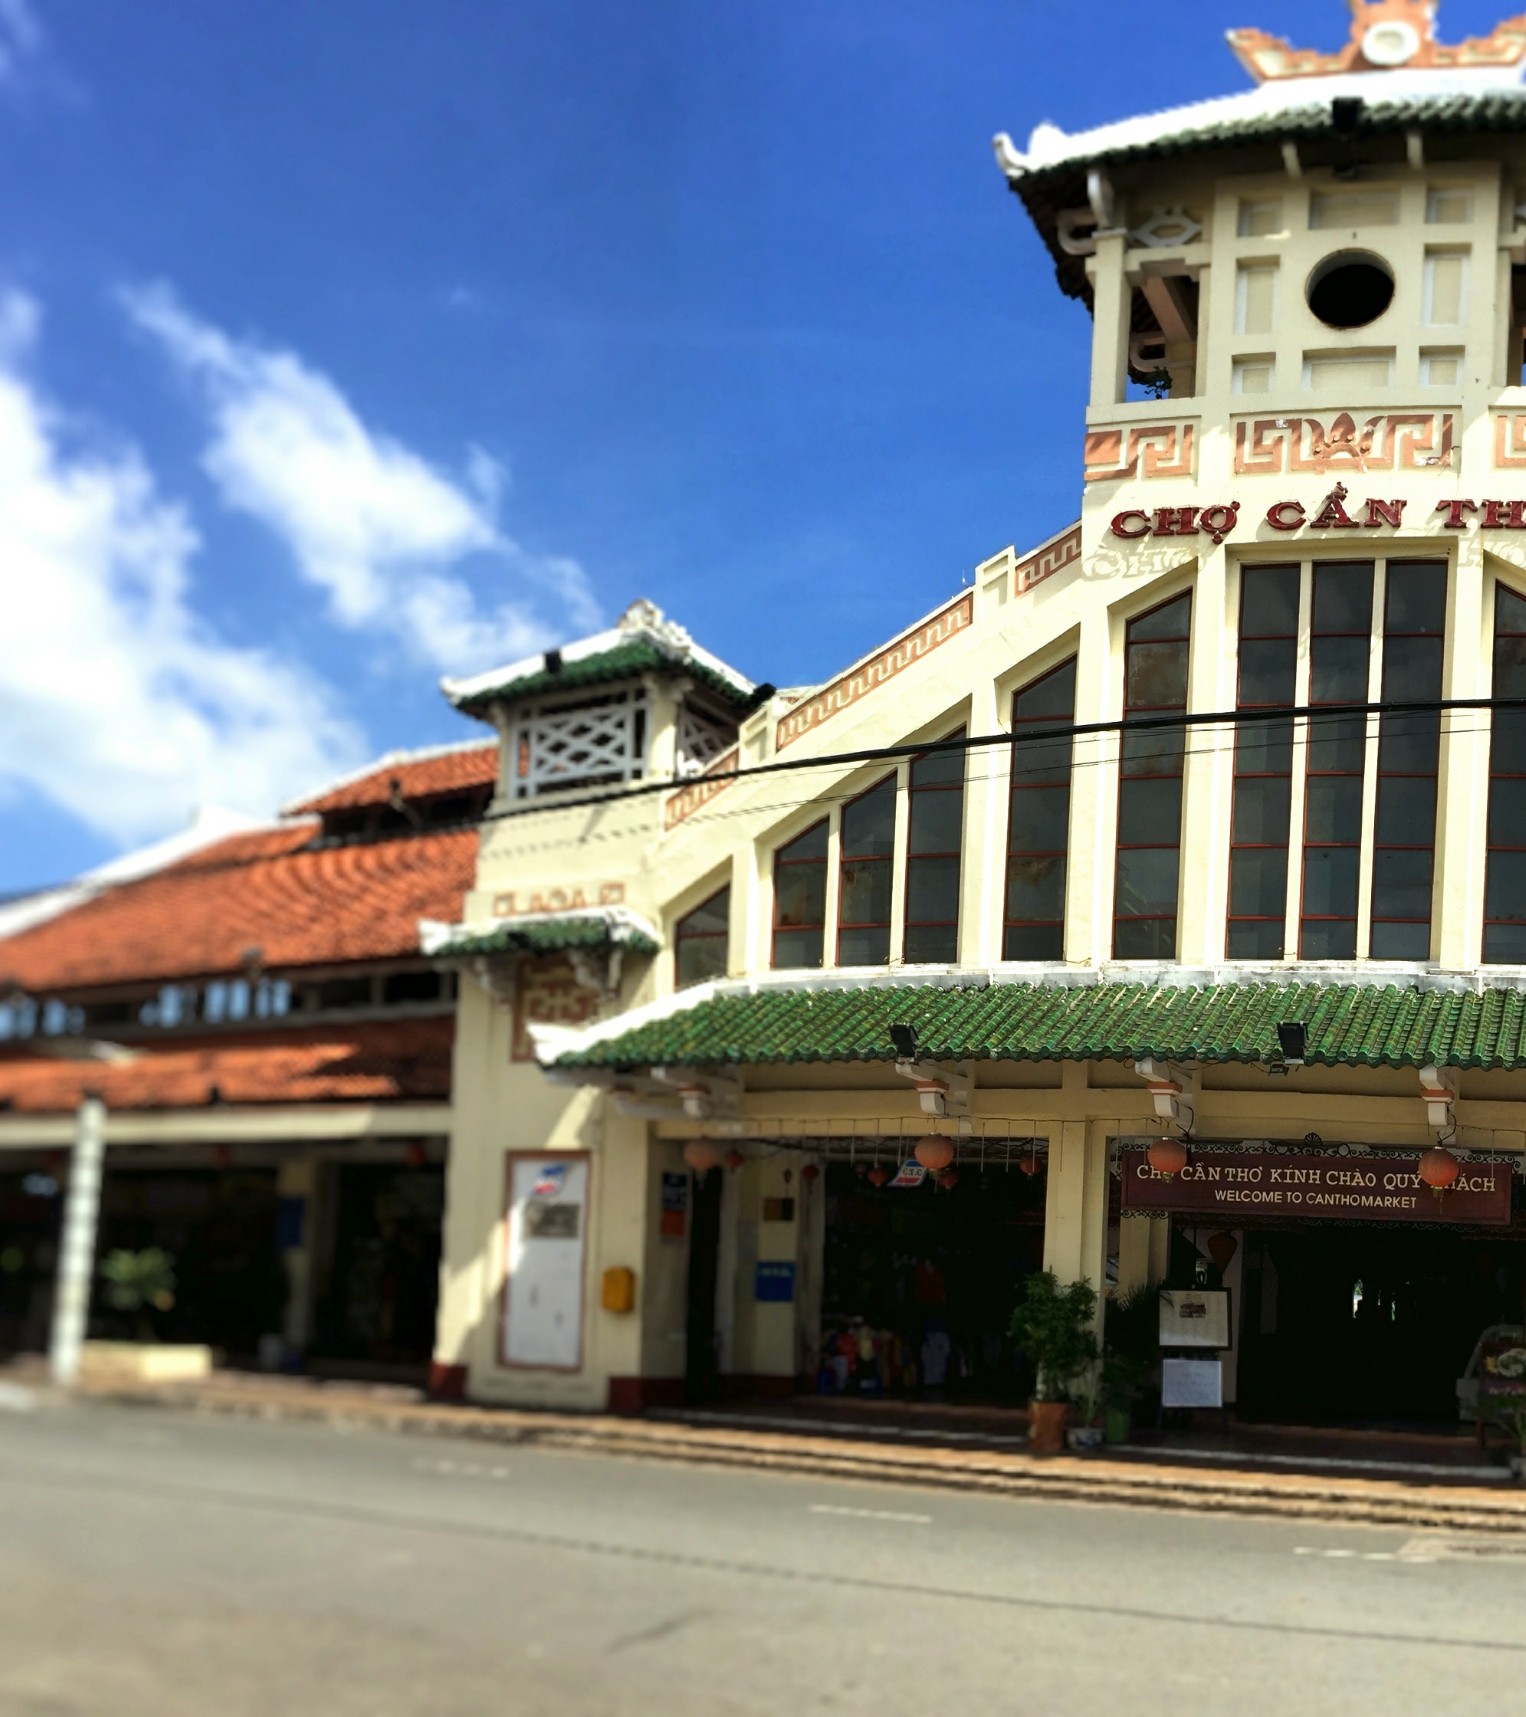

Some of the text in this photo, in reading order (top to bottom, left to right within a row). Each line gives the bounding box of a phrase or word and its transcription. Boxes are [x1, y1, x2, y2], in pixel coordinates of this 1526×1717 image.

[1110, 500, 1241, 545] CHỢ
[1136, 1164, 1174, 1183] CH
[1180, 1162, 1221, 1182] CẦN
[1225, 1166, 1263, 1183] THƠ
[1270, 1164, 1321, 1185] KÍNH
[1326, 1168, 1377, 1188] CHÀO
[1430, 1173, 1496, 1192] ÁCH
[1214, 1190, 1283, 1203] WELCOME
[1286, 1192, 1302, 1204] TO
